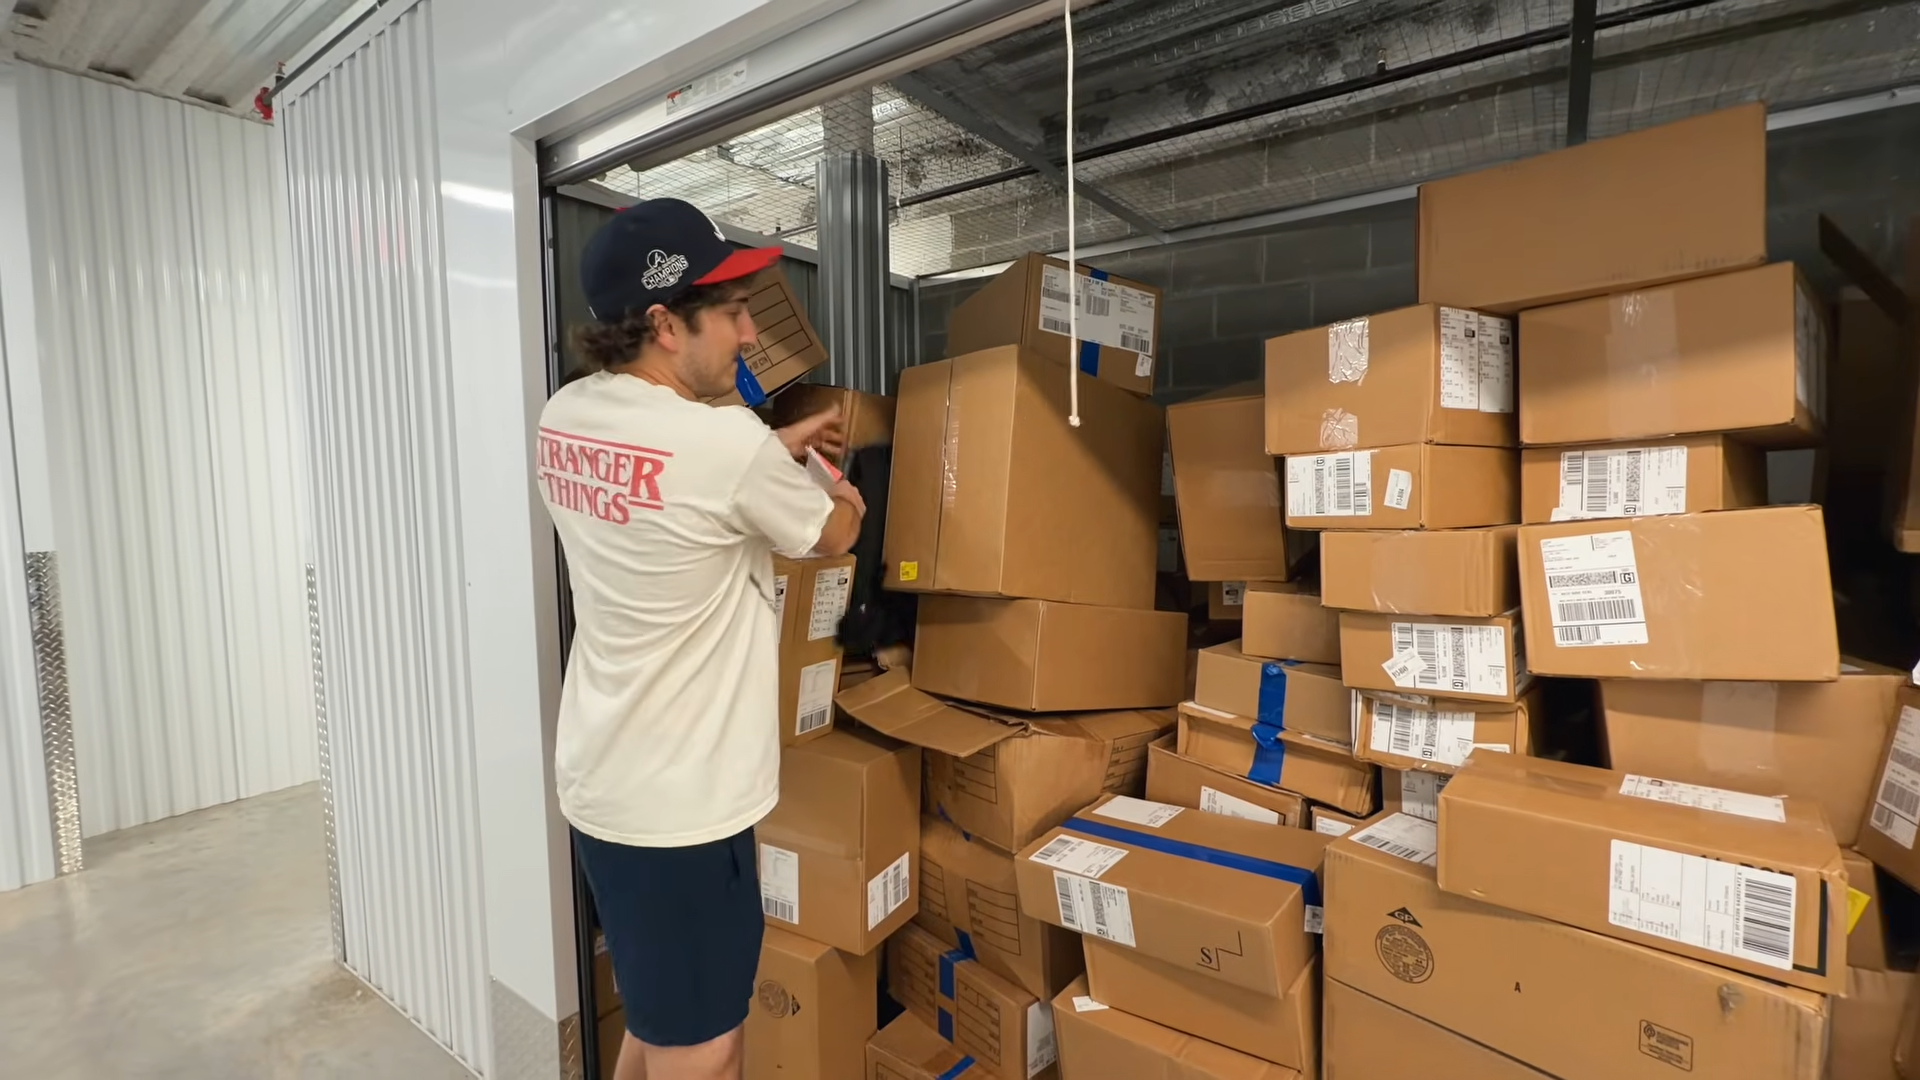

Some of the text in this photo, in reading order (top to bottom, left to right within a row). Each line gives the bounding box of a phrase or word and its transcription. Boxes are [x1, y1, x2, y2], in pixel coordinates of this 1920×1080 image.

[643, 256, 687, 288] CHAMPIONS
[538, 436, 664, 502] TRANGER
[541, 472, 631, 525] THINGS
[1623, 571, 1633, 583] G
[1394, 910, 1413, 922] GP
[1200, 947, 1212, 964] S
[1514, 981, 1521, 993] A
